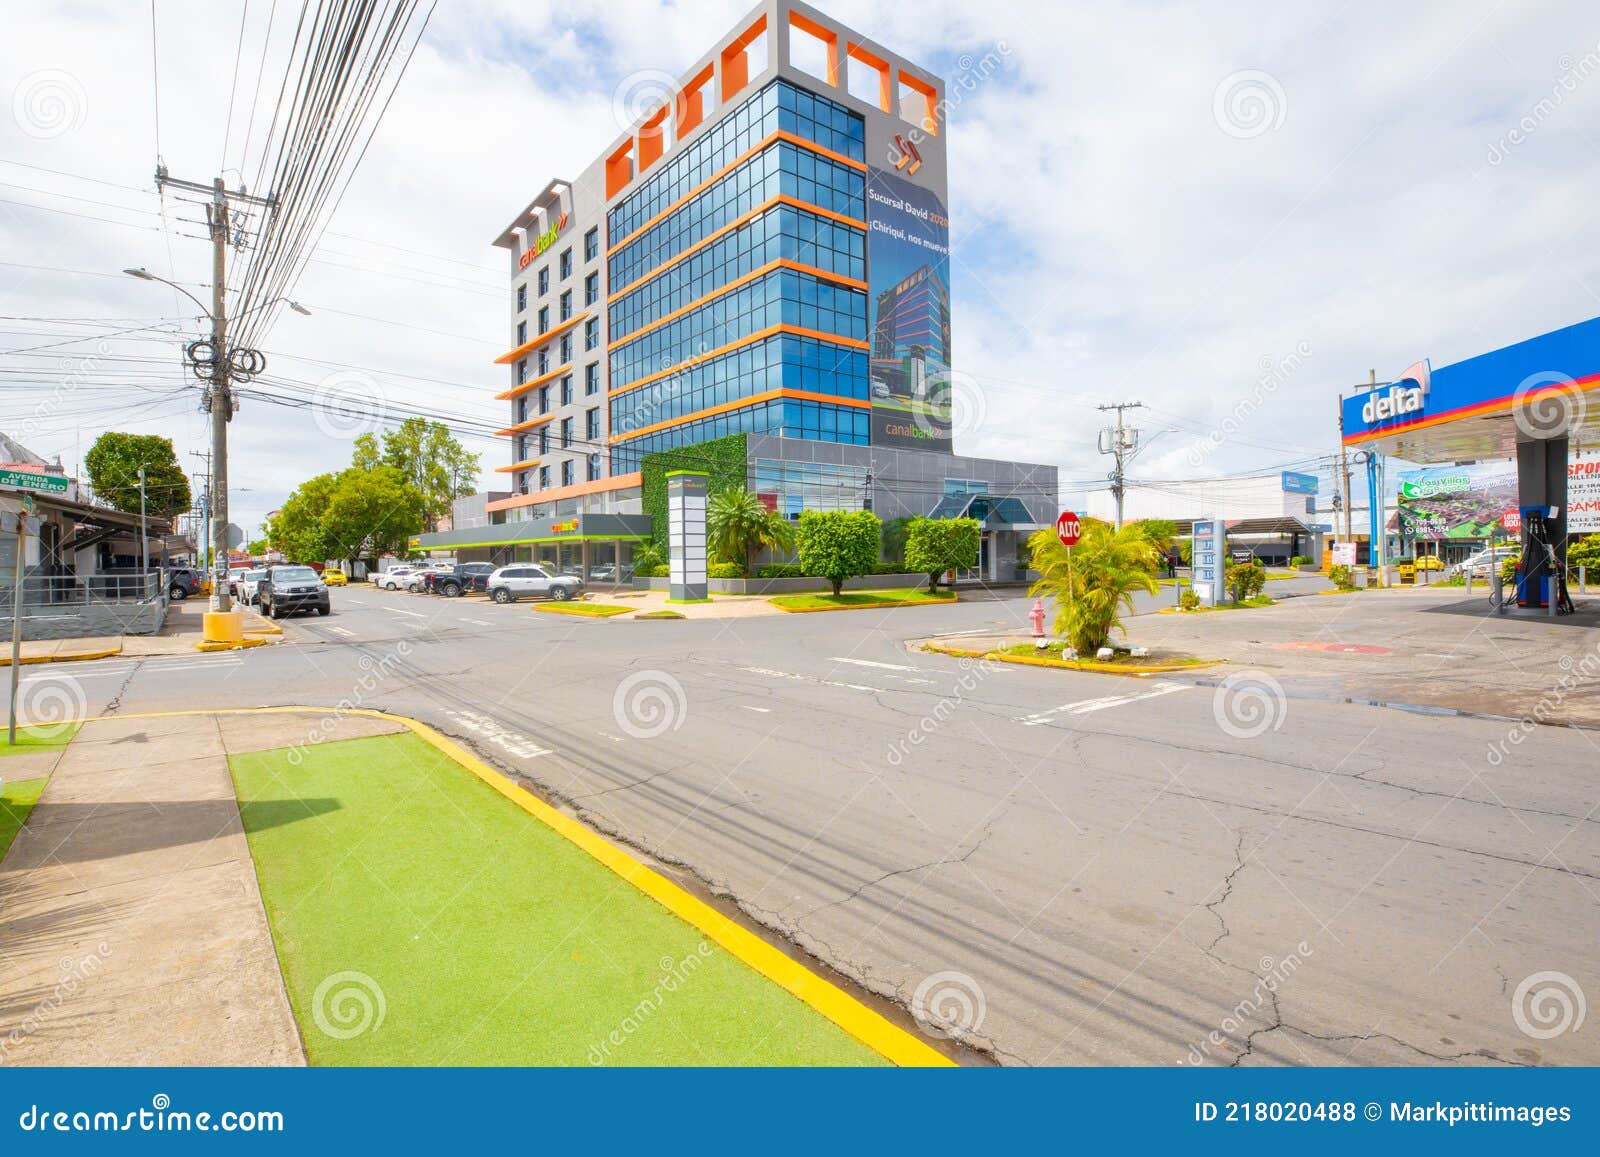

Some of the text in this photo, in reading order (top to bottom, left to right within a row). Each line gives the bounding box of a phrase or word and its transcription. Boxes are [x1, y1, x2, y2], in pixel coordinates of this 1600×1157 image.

[869, 188, 903, 211] Sucursal
[905, 202, 928, 219] David
[908, 234, 921, 245] nos
[1363, 386, 1423, 423] delta
[885, 423, 935, 440] canalbank
[1, 477, 66, 491] DE ENERO
[8, 473, 49, 484] AVENIDA
[1058, 520, 1080, 538] ALTO
